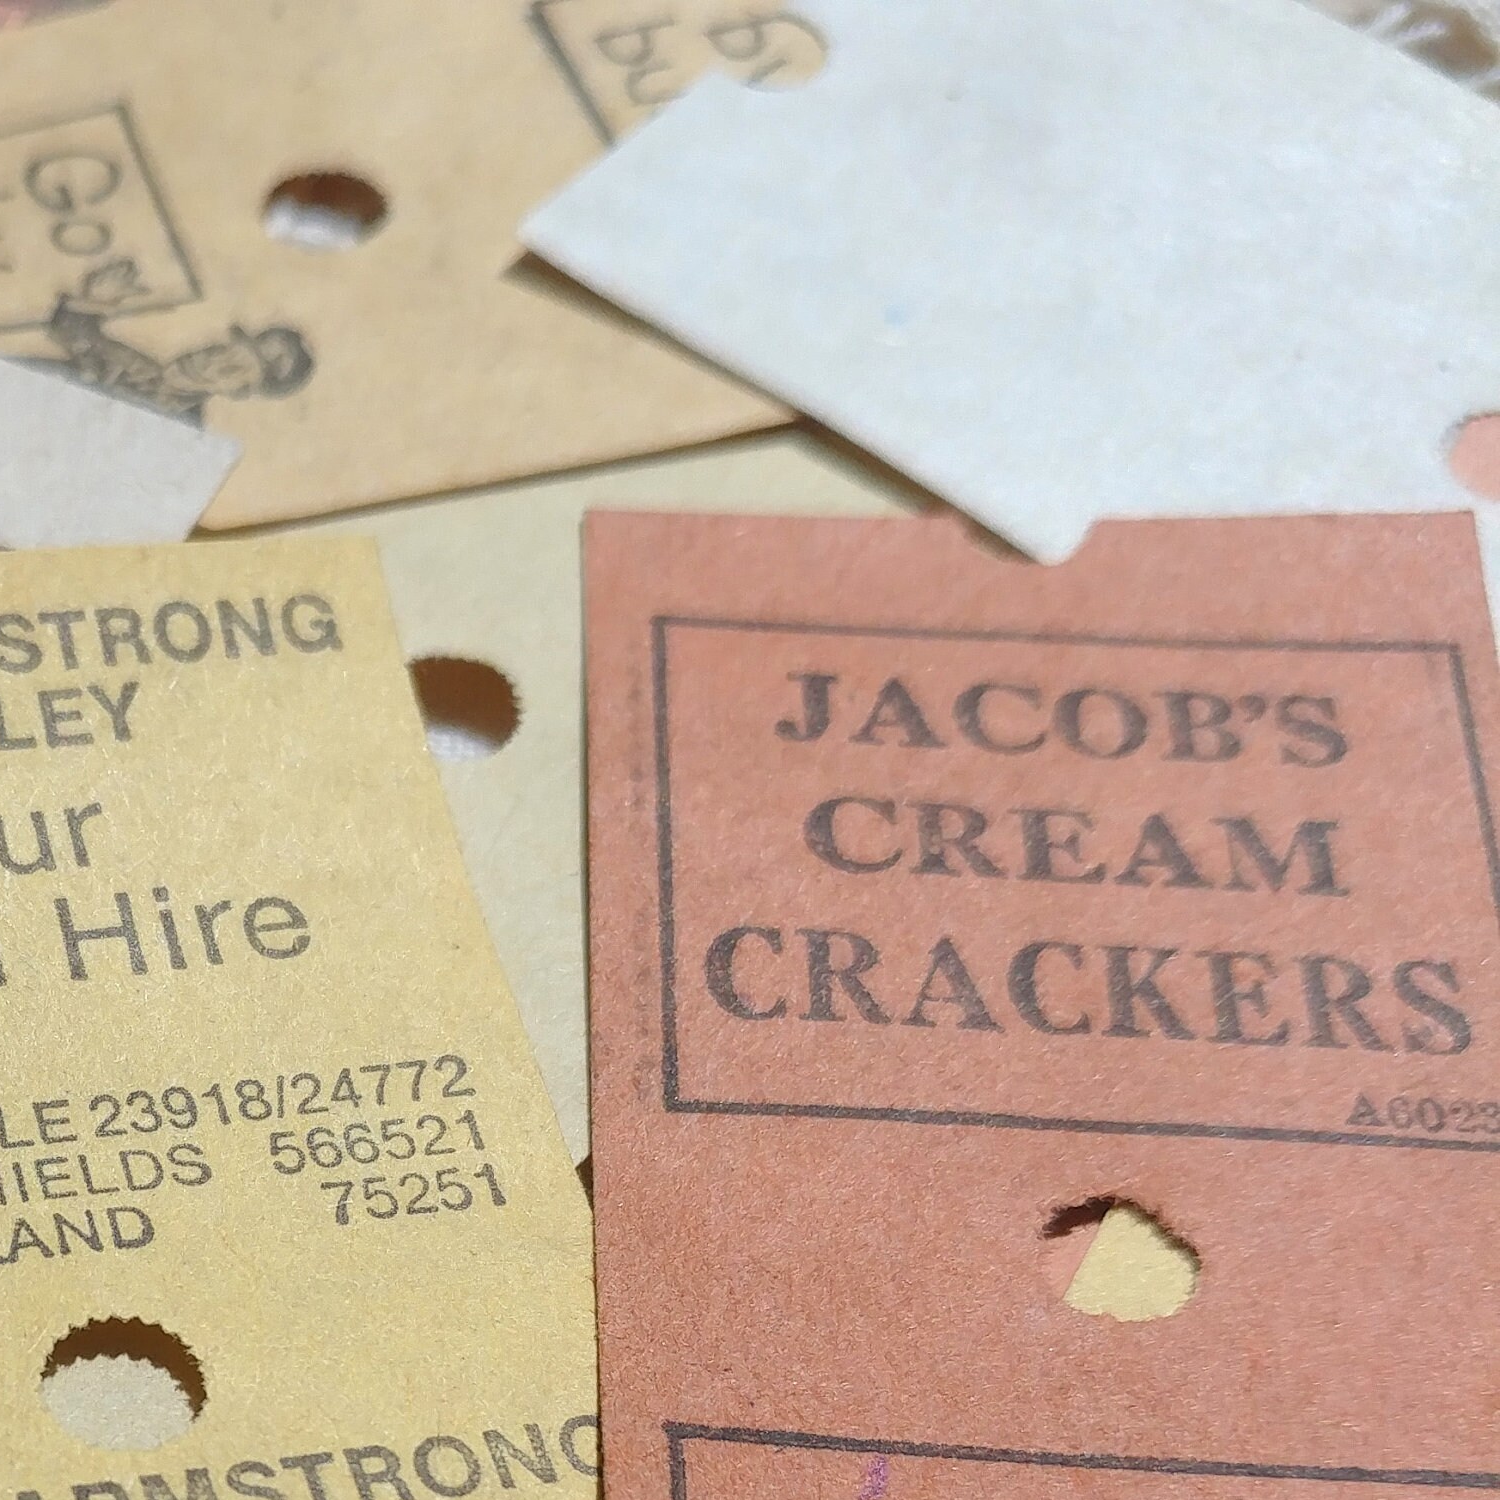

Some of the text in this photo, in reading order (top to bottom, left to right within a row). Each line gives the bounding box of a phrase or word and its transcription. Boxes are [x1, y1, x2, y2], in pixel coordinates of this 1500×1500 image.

[23, 150, 122, 257] Go
[774, 669, 1348, 769] JACOB'S
[803, 794, 1351, 898] CREAM
[54, 886, 311, 982] Hire
[702, 924, 1473, 1057] CRACKERS
[87, 1053, 476, 1139] 23918/24772
[270, 1109, 487, 1176] 566521
[320, 1162, 508, 1227] 75251
